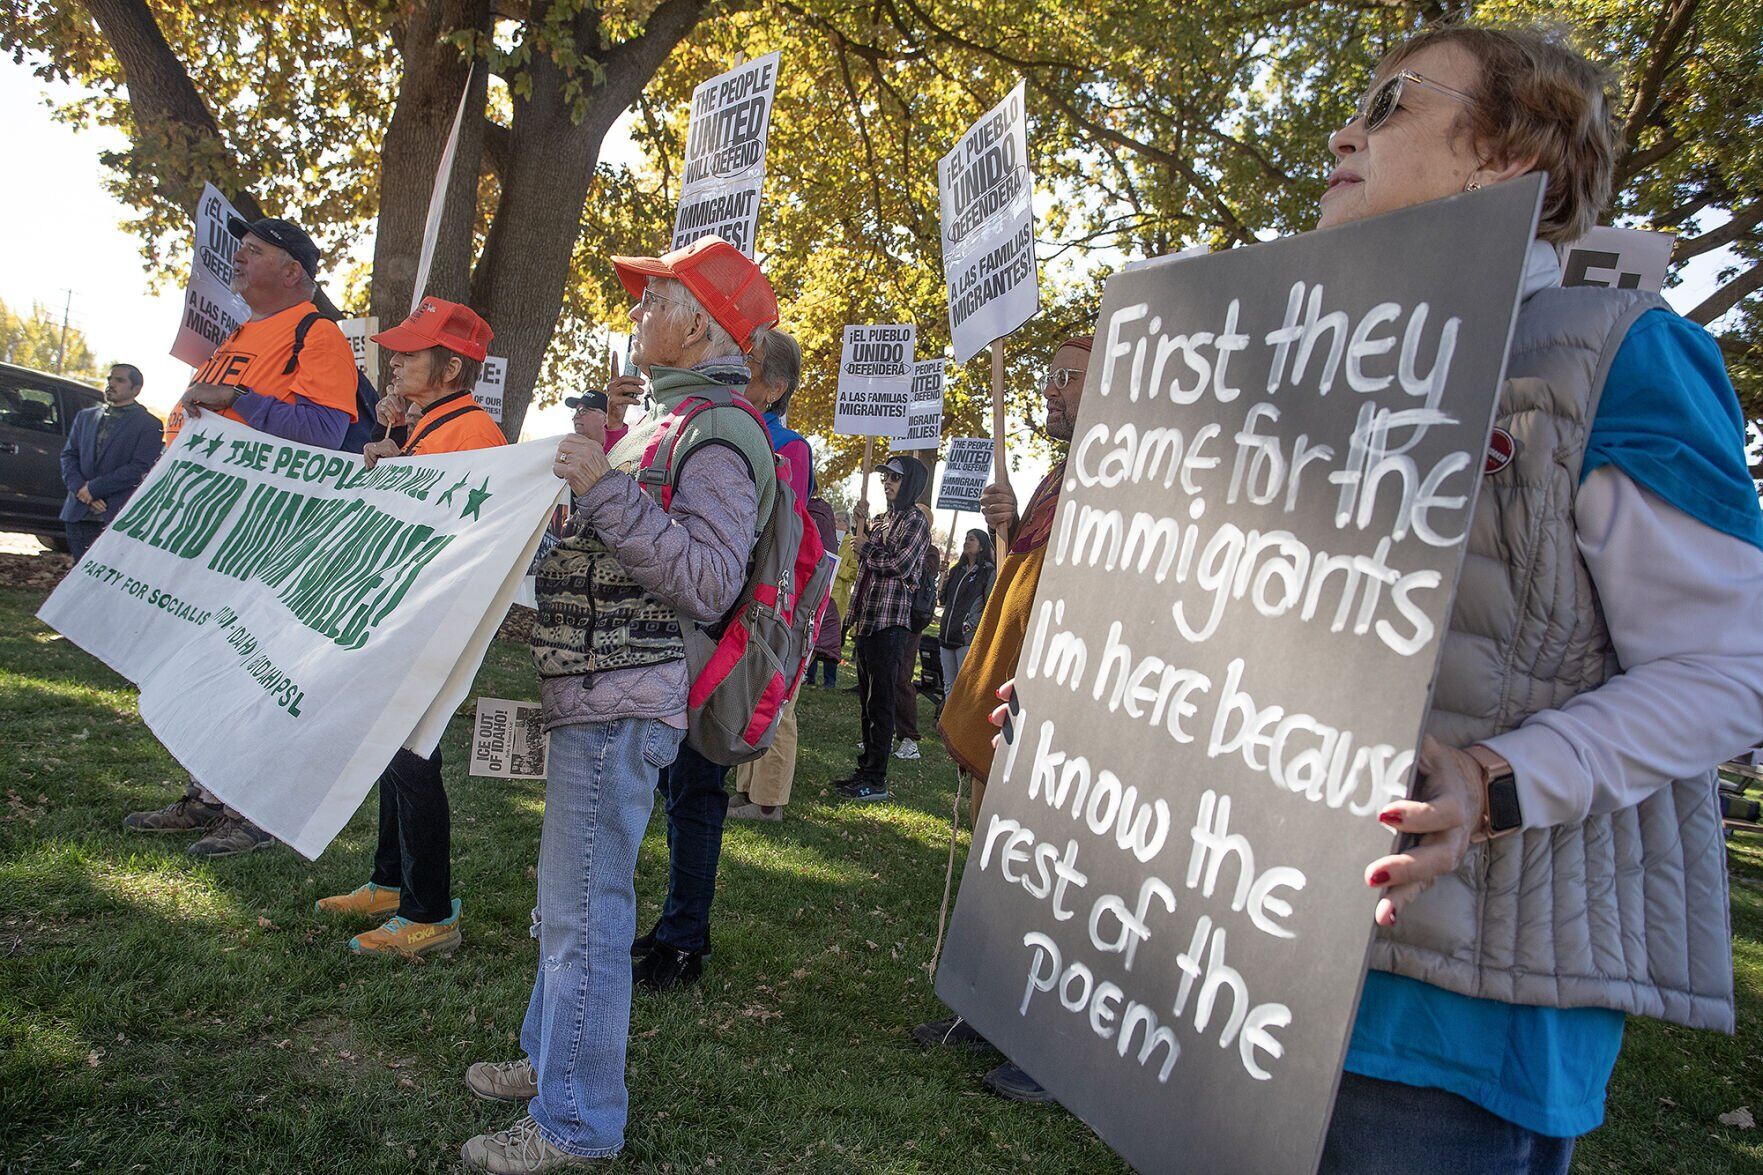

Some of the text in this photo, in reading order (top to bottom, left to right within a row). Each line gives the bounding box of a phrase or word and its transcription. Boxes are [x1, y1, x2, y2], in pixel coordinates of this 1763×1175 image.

[695, 63, 772, 118] THE PEOPLE
[689, 96, 766, 161] UNITED
[947, 95, 1018, 190] ¡EL PUEBLO
[686, 140, 760, 184] WILL DEFEND
[953, 132, 1017, 217] UNIDO
[678, 189, 756, 231] IMMIGRANT
[951, 222, 1030, 303] A LAS FAMILIAS
[189, 290, 197, 307] A
[200, 296, 219, 321] LAS
[953, 247, 1032, 328] MIGRANTES!
[849, 329, 910, 344] ¡EL PUEBLO
[853, 343, 904, 363] UNIDO
[848, 361, 905, 375] DEFENDERÁ
[915, 362, 942, 375] PEOPLE
[1100, 280, 1463, 456] First they
[485, 397, 501, 406] OUR
[839, 403, 906, 417] MIGRANTES!
[840, 392, 908, 403] A LAS FAMILIAS
[914, 390, 940, 402] DEFEND
[223, 440, 274, 471] THE
[272, 446, 369, 491] PEOPLE
[950, 450, 991, 464] UNITED
[953, 440, 995, 450] THE PEOPLE
[963, 463, 988, 472] DEFEND
[941, 486, 982, 498] FAMILIES!
[943, 477, 985, 488] IMMIGRANT
[1075, 400, 1472, 548] came for the
[112, 459, 248, 559] DEFEND
[1055, 481, 1443, 656] immigrants
[82, 560, 124, 586] PARTY
[121, 577, 149, 600] FOR
[148, 588, 212, 626] SOCIALIS
[477, 713, 494, 761] ICE OUT
[1026, 599, 1416, 836] I'm here because
[489, 710, 508, 772] OF IDAHO!
[1003, 708, 1307, 939] I know the
[407, 926, 435, 944] HOKA
[980, 813, 1293, 1081] rest of the
